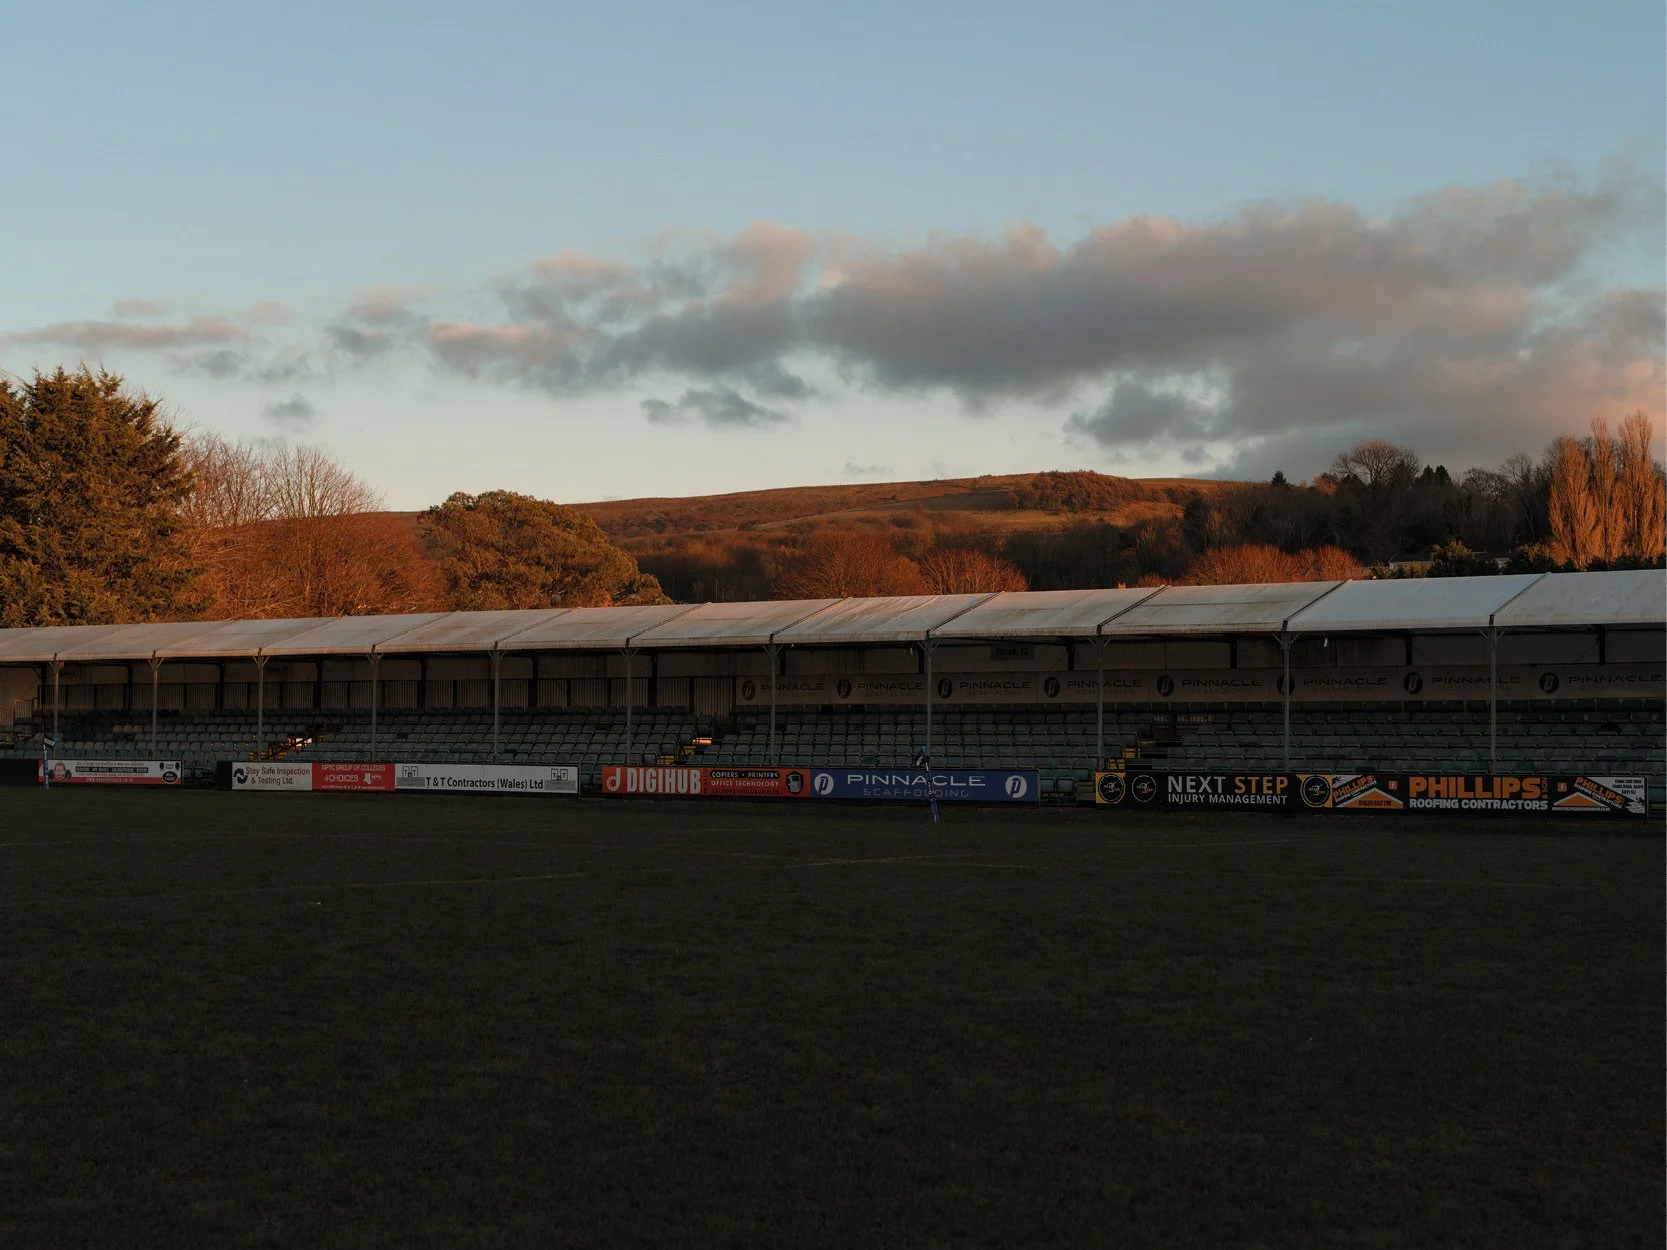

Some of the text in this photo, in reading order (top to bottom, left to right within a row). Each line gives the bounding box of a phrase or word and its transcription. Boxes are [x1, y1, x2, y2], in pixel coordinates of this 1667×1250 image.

[1182, 679, 1261, 687] PINNACLE
[1303, 677, 1388, 686] PINNACLE
[1568, 675, 1663, 683] PINNACLE
[858, 682, 924, 690] PINNACLE
[959, 681, 1031, 690] PINNACLE
[246, 767, 311, 776] Stay Safe Inspection
[258, 777, 281, 786] Testing
[282, 777, 295, 785] Ltd.
[426, 777, 432, 786] T
[433, 777, 439, 786] &
[440, 777, 446, 786] T
[447, 777, 495, 788] Contractors
[497, 779, 528, 790] (Wales)
[530, 779, 544, 789] Ltd
[627, 767, 701, 794] DIGIHUB
[847, 775, 985, 786] PINNACLE
[1168, 775, 1226, 793] NEXT
[1234, 776, 1288, 794] STEP
[1409, 776, 1541, 799] PHILLIPS
[1576, 776, 1624, 805] PHILLIPS
[1168, 793, 1288, 804] INJURY MANAGEMENT
[1409, 799, 1459, 809] ROOFING
[1461, 800, 1549, 810] CONTRACTORS
